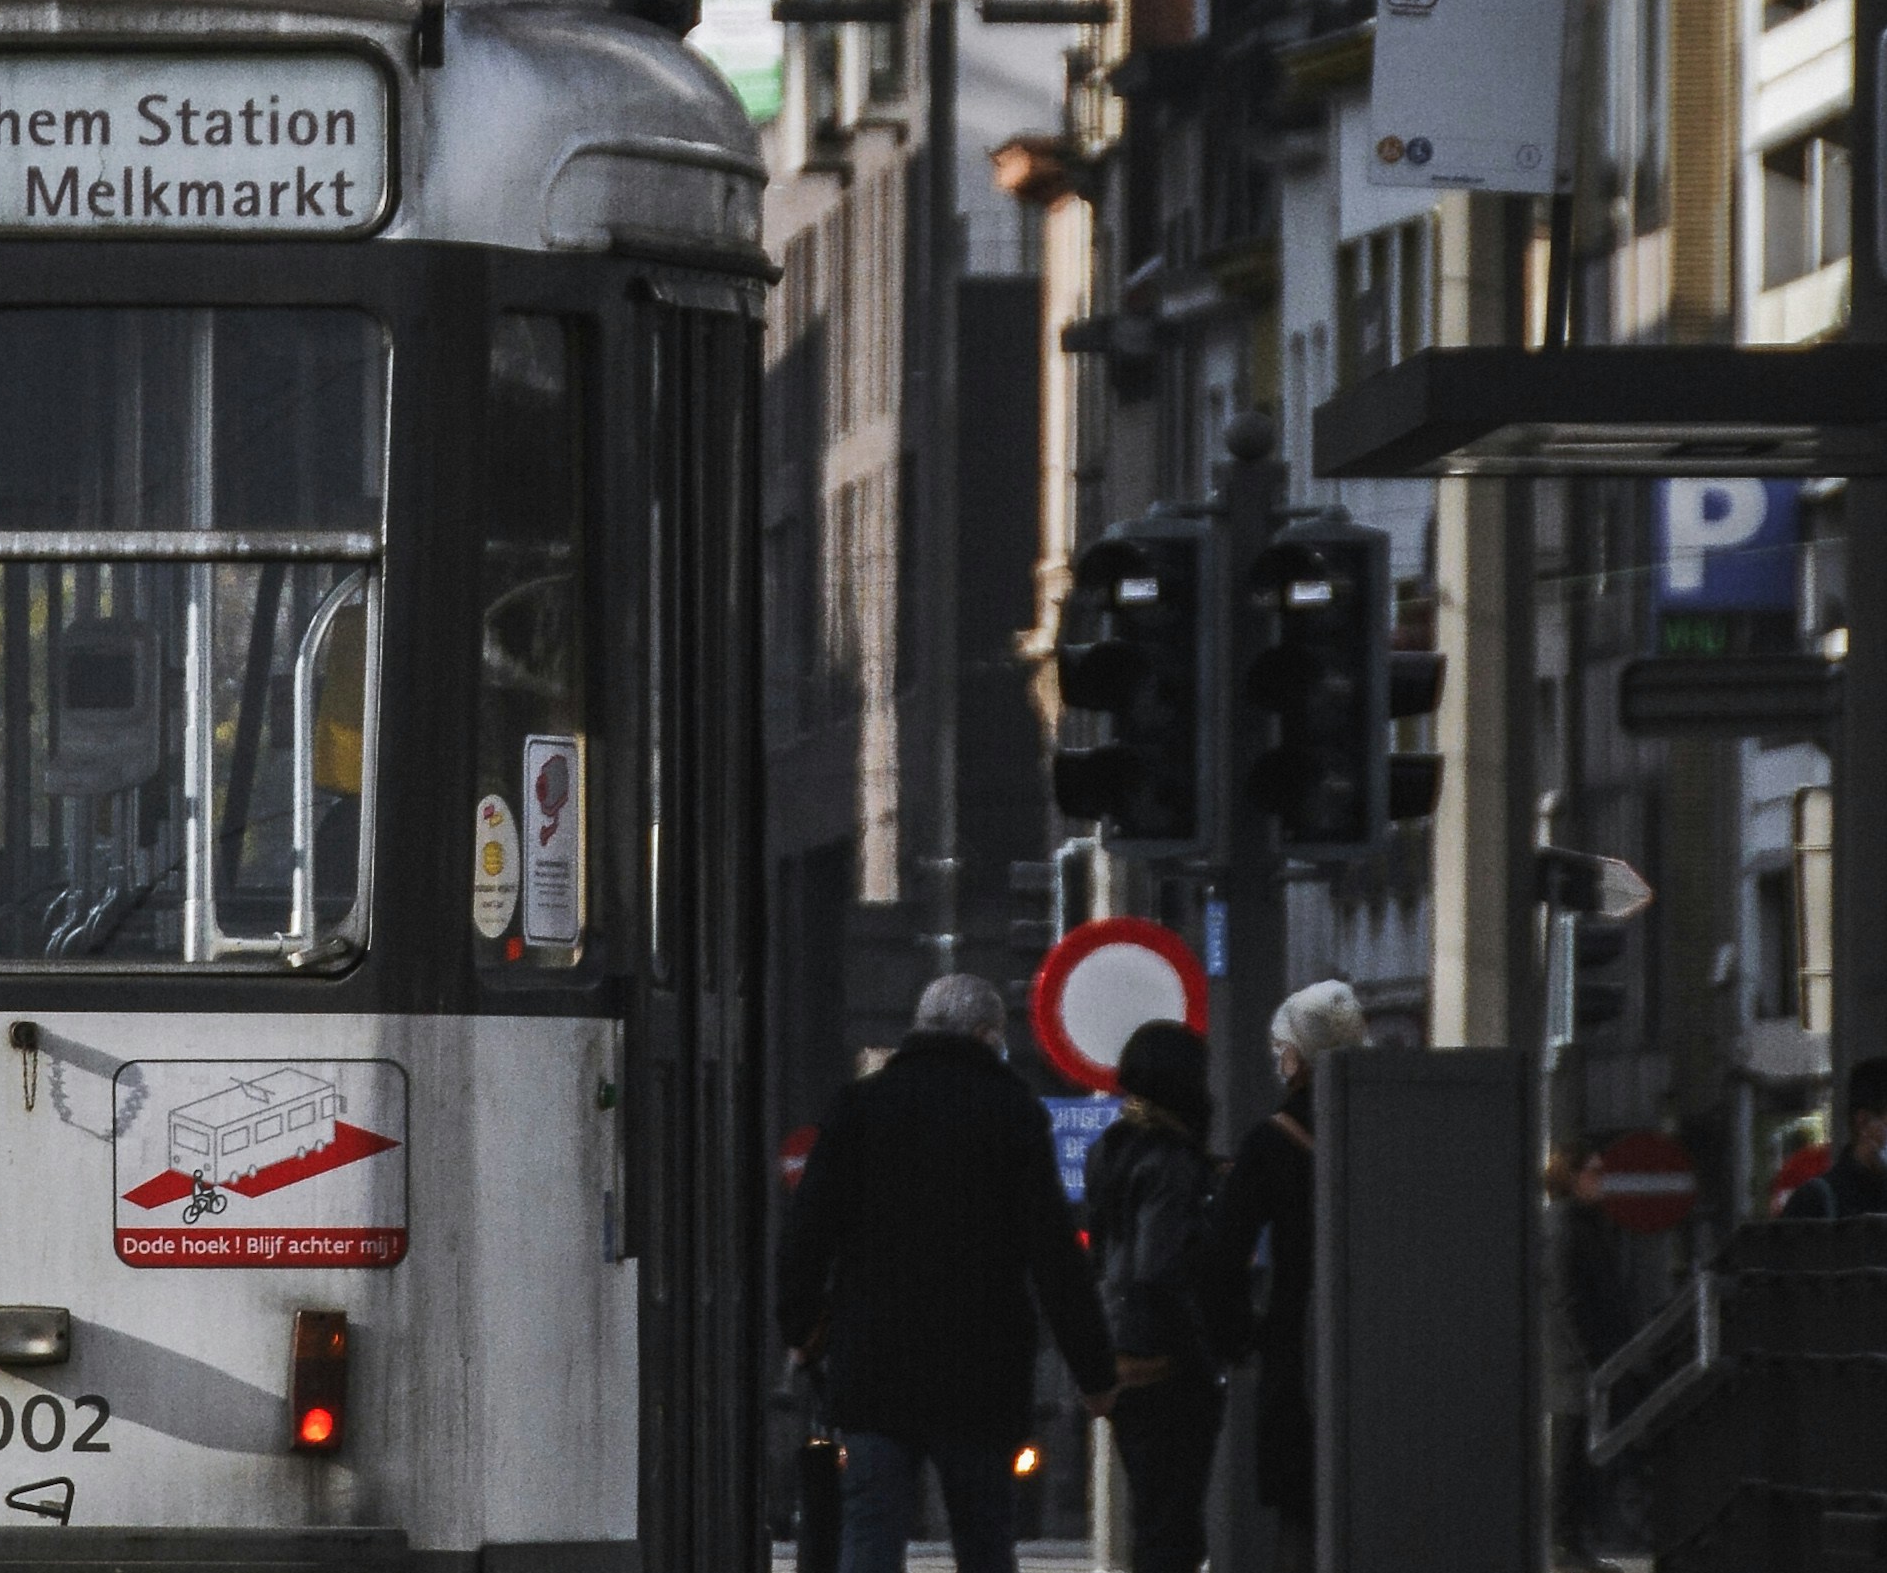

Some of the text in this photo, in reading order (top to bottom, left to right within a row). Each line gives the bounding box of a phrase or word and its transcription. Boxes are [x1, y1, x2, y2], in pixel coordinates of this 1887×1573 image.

[137, 92, 357, 148] Station
[26, 165, 355, 219] Melkmarkt
[1669, 477, 1769, 588] P
[123, 1237, 175, 1255] Dode
[181, 1236, 231, 1255] hoek
[246, 1236, 285, 1259] Blijf
[288, 1237, 354, 1255] achter
[360, 1237, 389, 1259] mij
